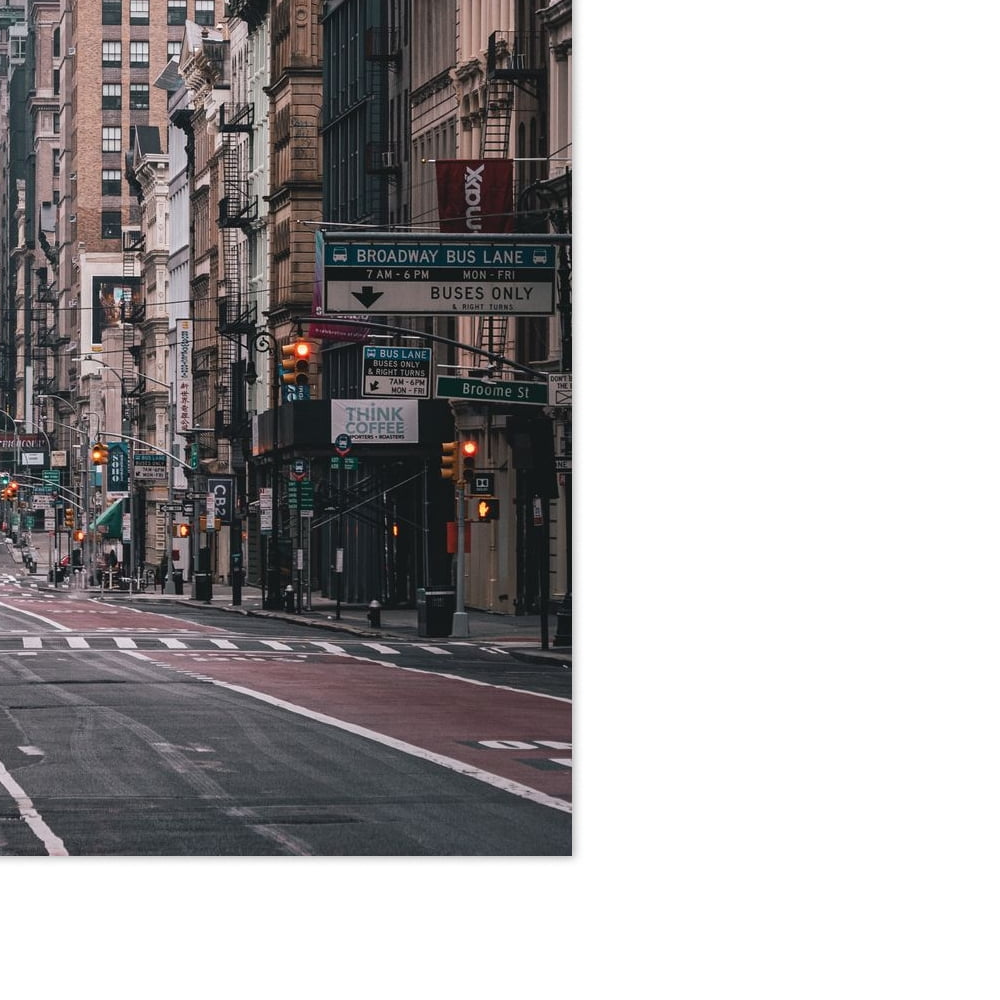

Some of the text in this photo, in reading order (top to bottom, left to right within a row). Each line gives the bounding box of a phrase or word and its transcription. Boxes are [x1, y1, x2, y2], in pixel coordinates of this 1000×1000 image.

[357, 249, 524, 264] BROADWAY BUS LANE
[366, 269, 373, 279] 7
[376, 269, 393, 279] AM
[403, 269, 411, 279] 6
[414, 270, 430, 279] PM
[431, 286, 534, 300] BUSES ONLY
[380, 349, 427, 359] BUS LANE
[376, 368, 397, 376] RIGHT
[400, 369, 426, 377] TURNS
[391, 386, 407, 394] MON
[413, 387, 425, 395] FRI
[462, 382, 529, 398] Broome St
[345, 421, 405, 434] COFFEE
[213, 484, 226, 516] CB2
